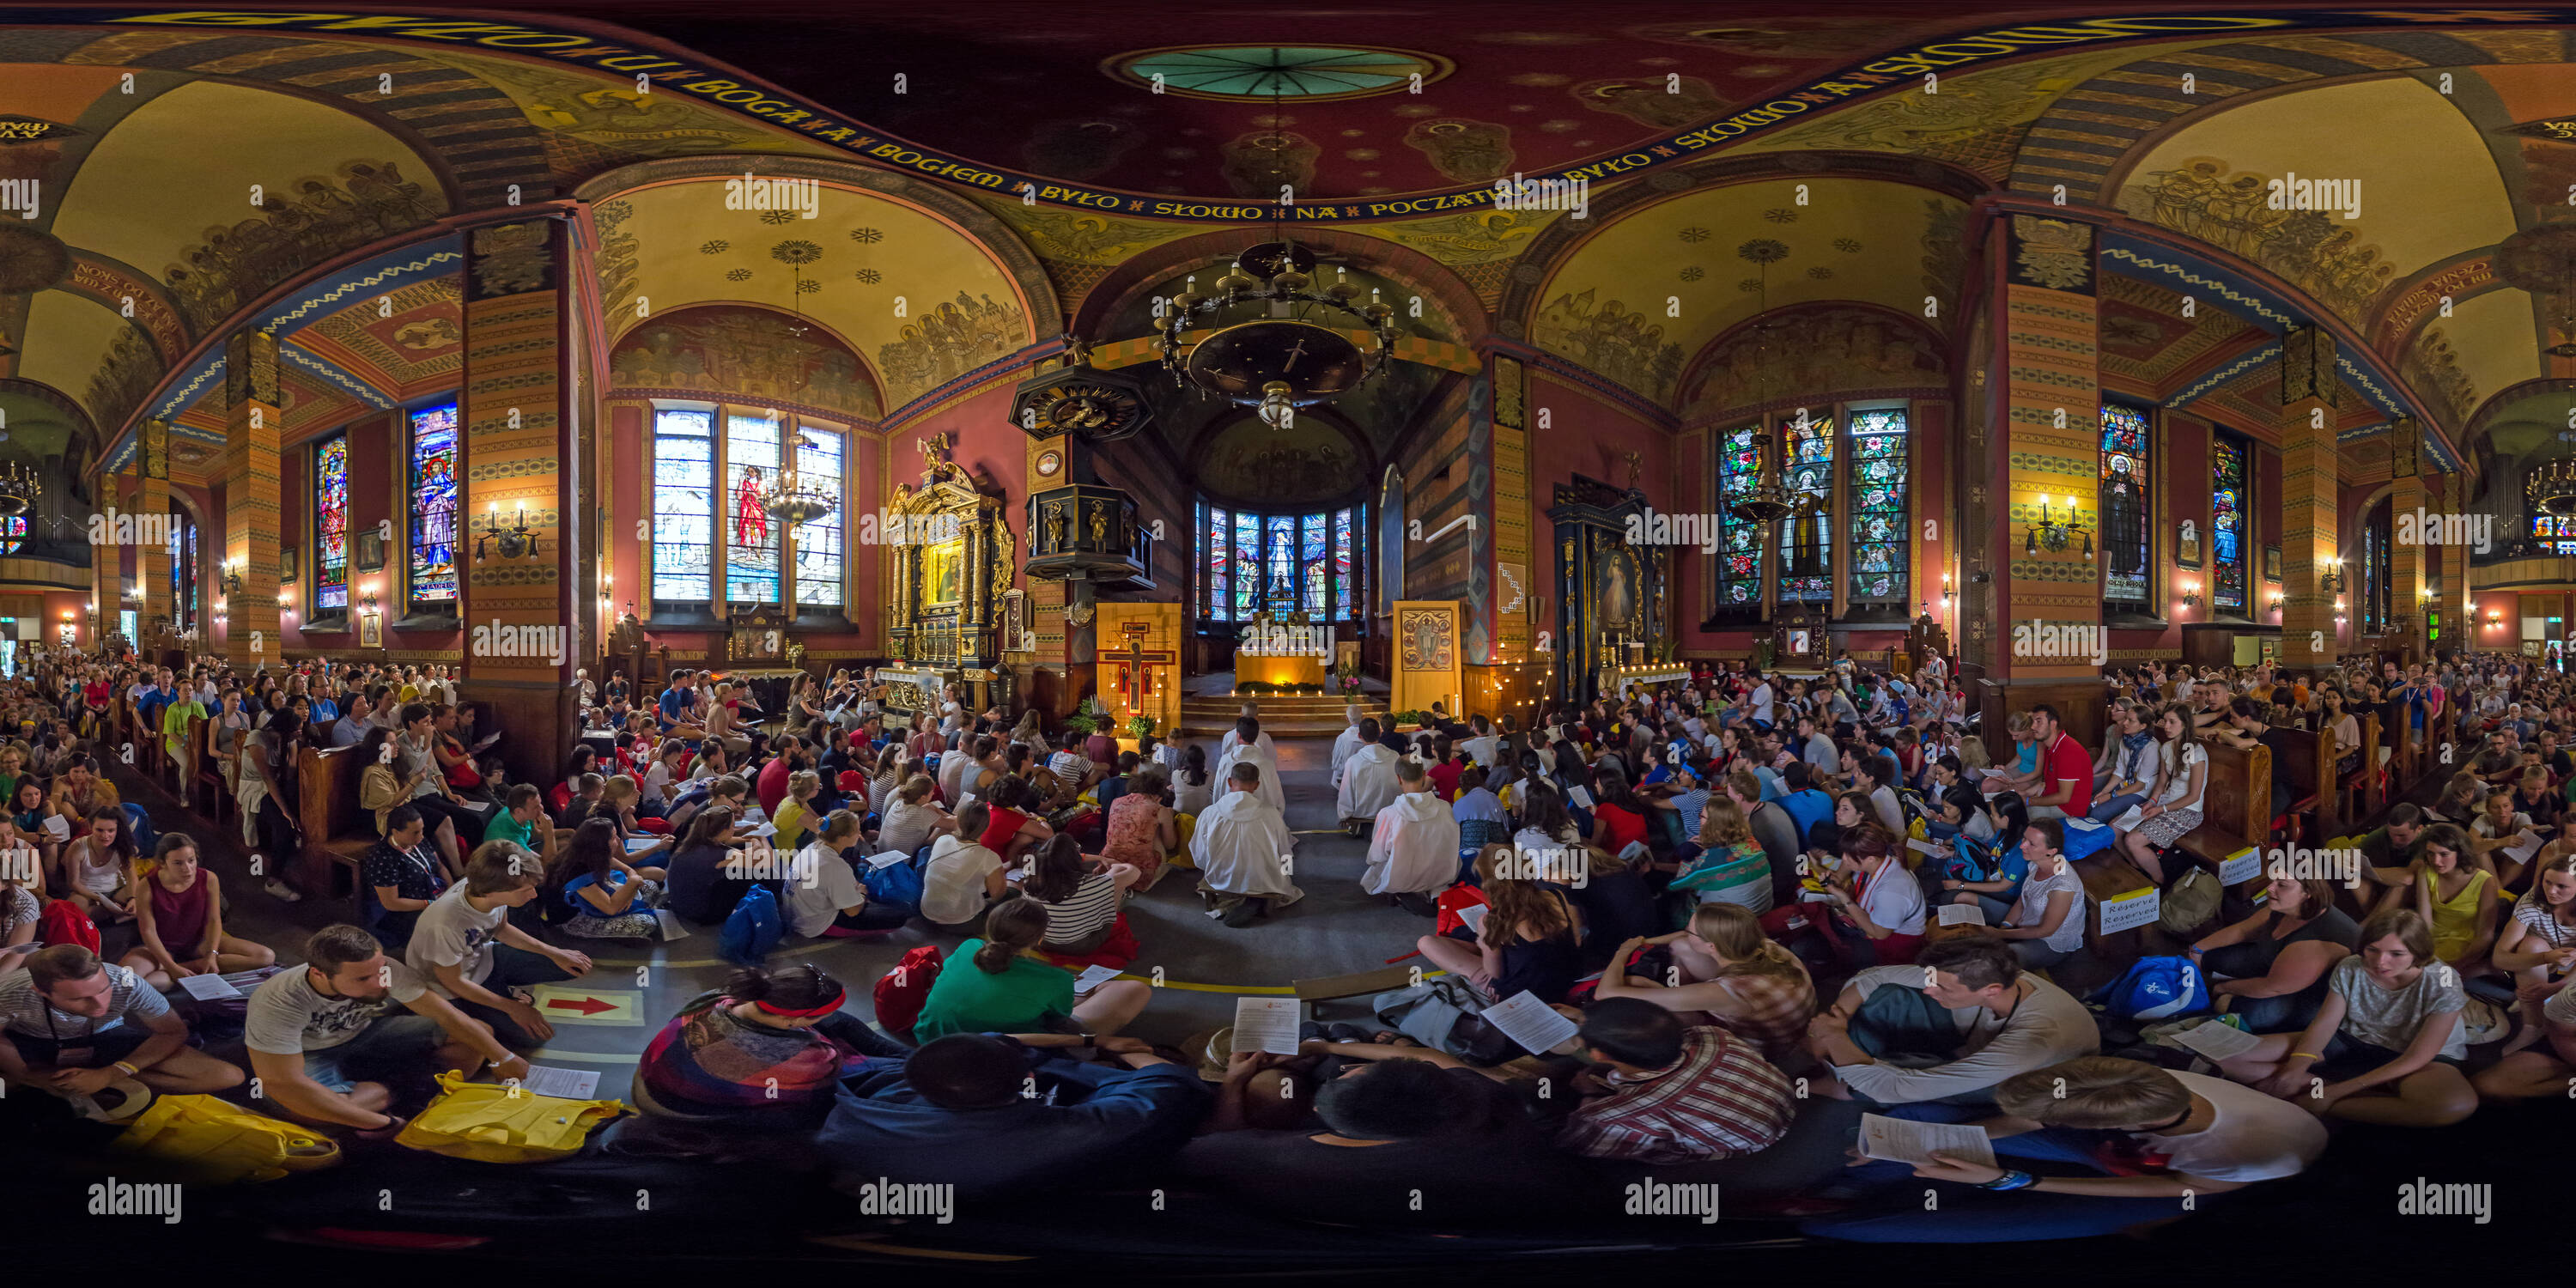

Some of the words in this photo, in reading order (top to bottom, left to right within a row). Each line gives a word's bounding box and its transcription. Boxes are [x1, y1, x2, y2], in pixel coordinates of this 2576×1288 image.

[680, 79, 812, 124] BOGA
[817, 126, 857, 142] A
[868, 143, 1005, 188] BOGIEM
[1038, 185, 1120, 209] BYŁO
[1154, 202, 1263, 220] SŁOWO
[1296, 207, 1339, 220] NA
[1562, 154, 1651, 182] BYŁO
[1674, 100, 1808, 149] SŁOWO
[1812, 81, 1872, 97] A
